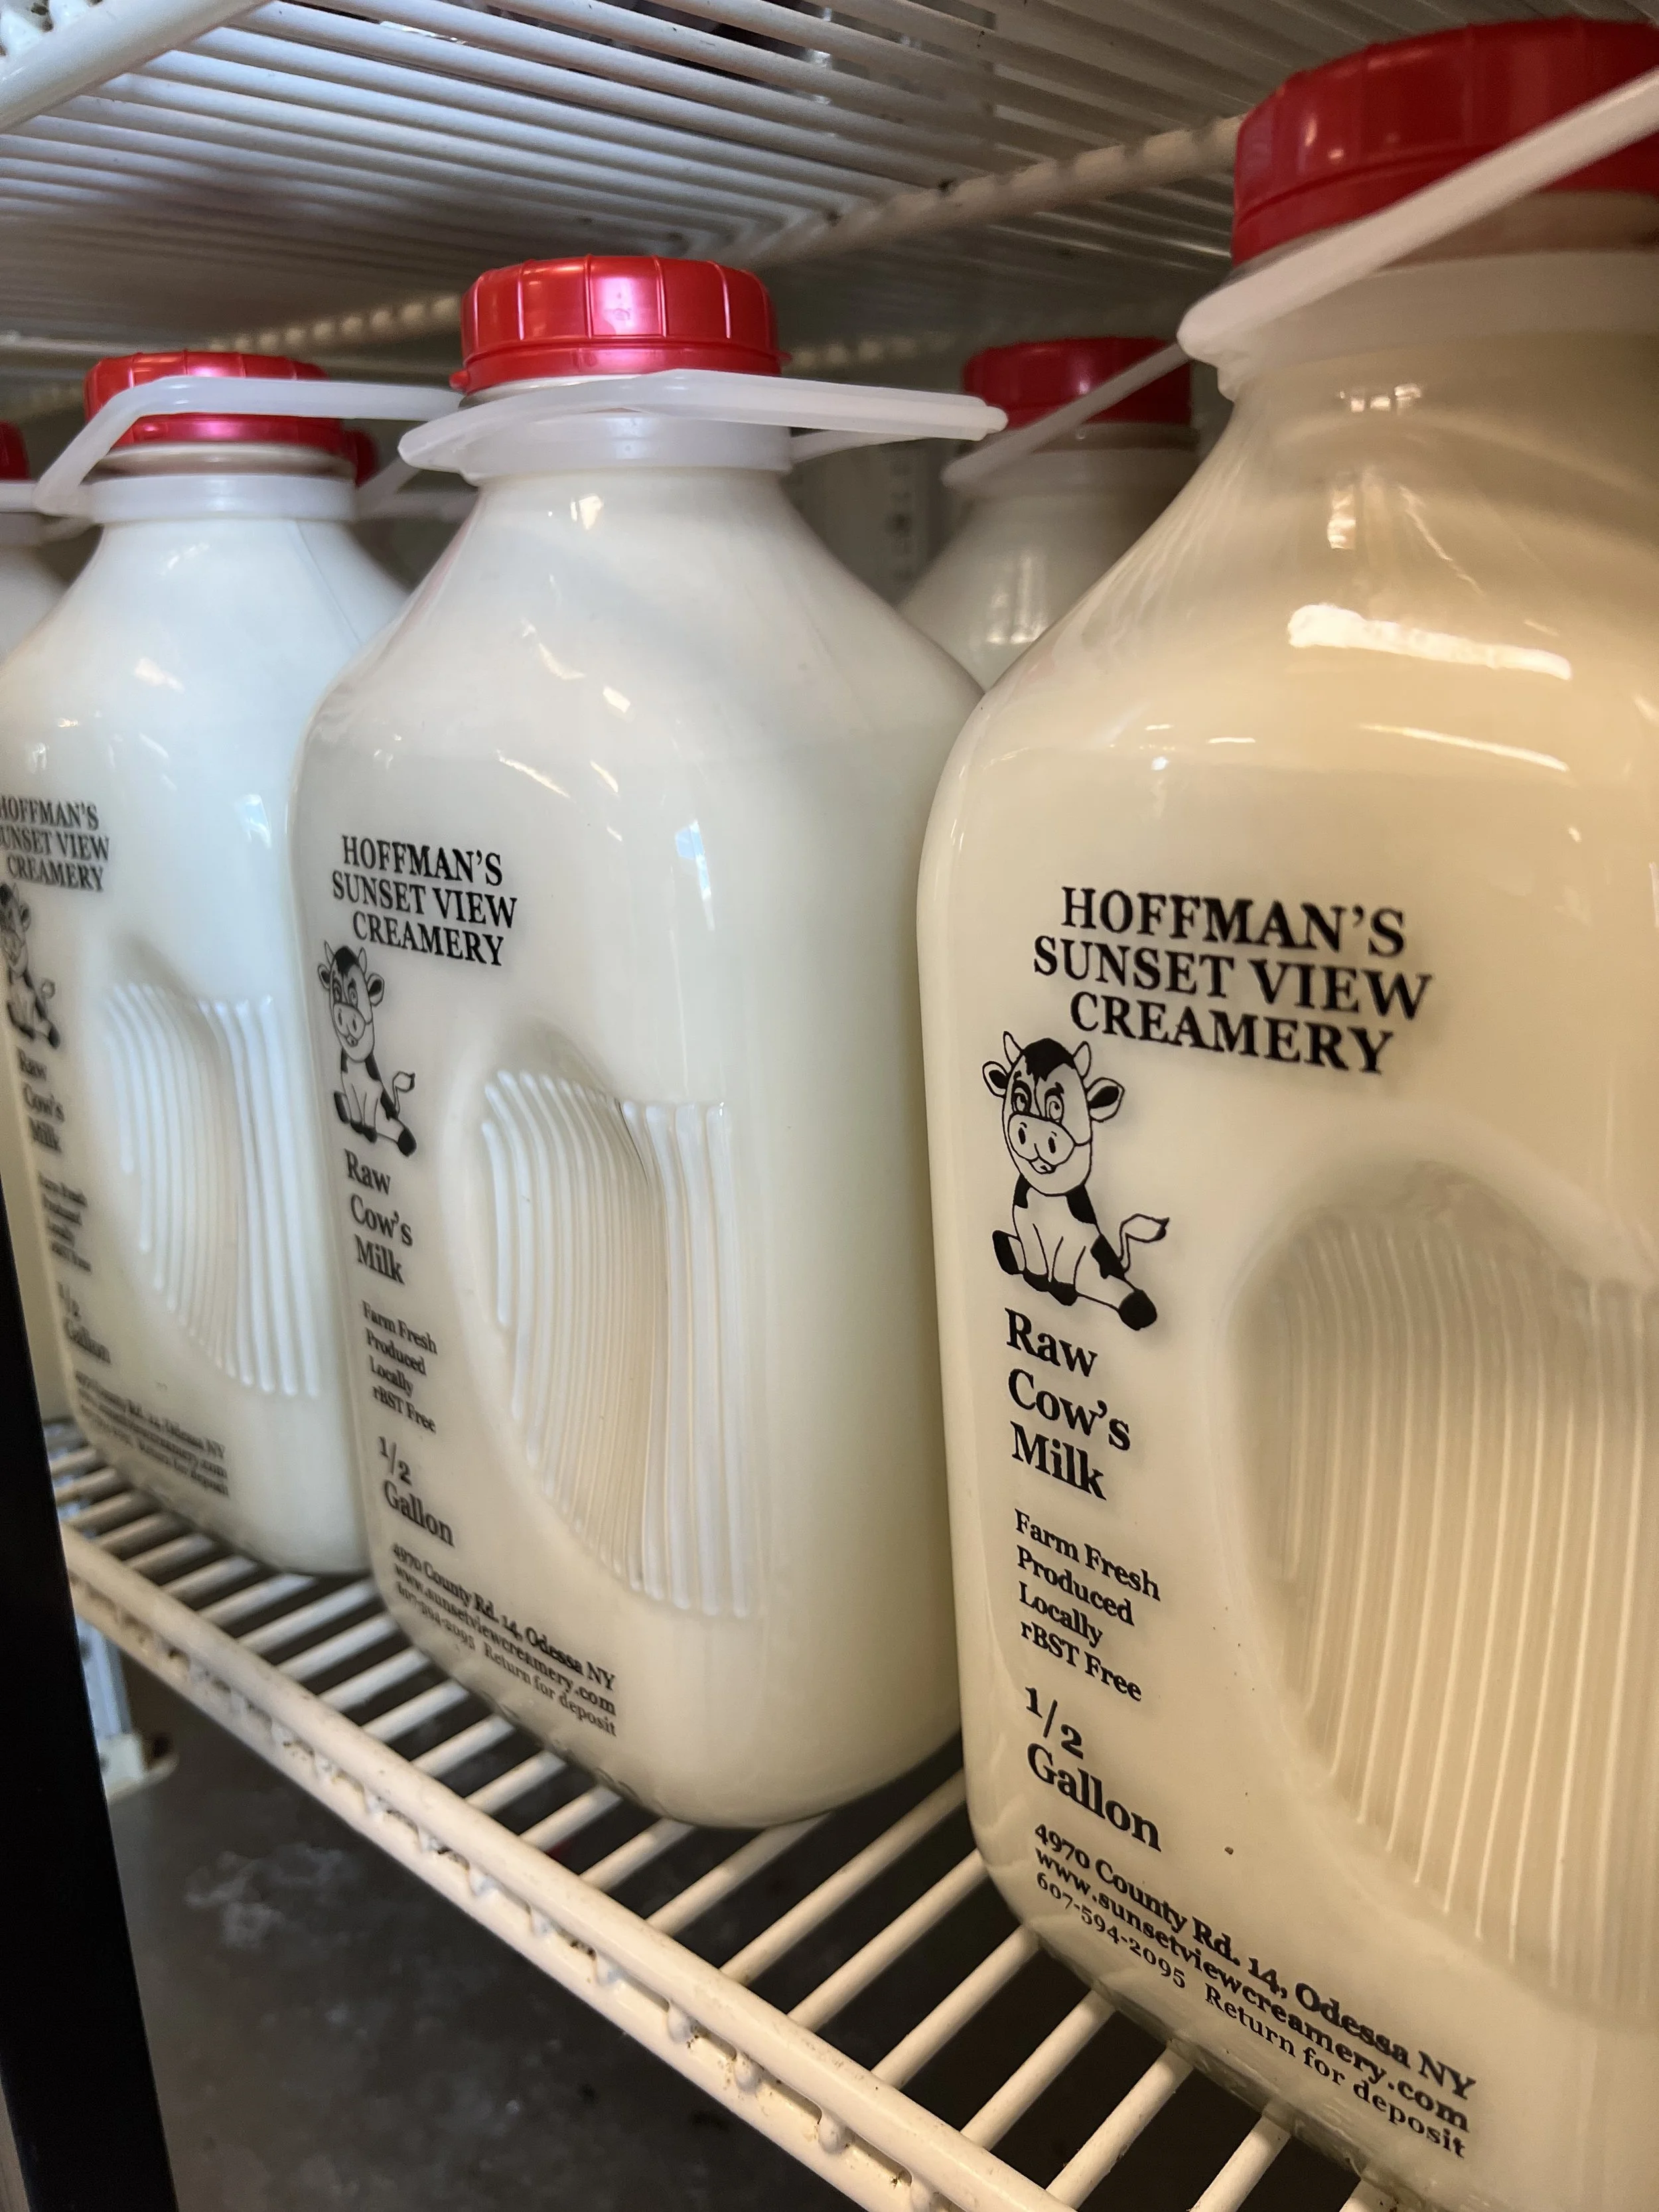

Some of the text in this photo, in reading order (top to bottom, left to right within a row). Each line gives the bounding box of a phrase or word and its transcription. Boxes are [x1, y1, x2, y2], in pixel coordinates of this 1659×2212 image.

[7, 853, 104, 893] CREAMERY
[56, 830, 109, 861] VIEW
[342, 834, 503, 887] HOFFMAN'S
[332, 869, 518, 929] SUNSET VIEW
[1061, 886, 1406, 958] HOFFMAN'S
[352, 910, 504, 967] CREAMERY
[1033, 935, 1434, 1021] SUNSET VIEW
[1069, 990, 1395, 1074] CREAMERY
[344, 1148, 392, 1195] Raw
[350, 1193, 413, 1247] Cow's
[354, 1233, 406, 1286] Milk
[362, 1299, 438, 1356] Farm Fresh
[365, 1327, 427, 1376] Produced
[1004, 1307, 1098, 1377] Raw
[368, 1354, 414, 1398] Locally
[1008, 1368, 1131, 1451] Cow's
[405, 1400, 437, 1434] Free
[378, 1436, 413, 1486] 1/2
[1009, 1420, 1107, 1501] Milk
[383, 1479, 456, 1548] Gallon
[1014, 1507, 1161, 1601] Farm Fresh
[1016, 1544, 1135, 1627] Produced
[423, 1560, 472, 1608] County
[525, 1627, 585, 1676] Odessa
[586, 1660, 616, 1692] NY
[1018, 1580, 1104, 1649] Locally
[483, 1641, 533, 1686] Return
[532, 1674, 556, 1700] for
[559, 1692, 617, 1737] deposit
[1020, 1621, 1142, 1702] rBST Free
[1025, 1686, 1084, 1760] 1/2
[1027, 1742, 1162, 1853] Gallon
[1034, 1823, 1477, 2101] 4970 County Rd. 14, Odessa NY
[1036, 1872, 1466, 2160] 607-594-2095 Return for deposit
